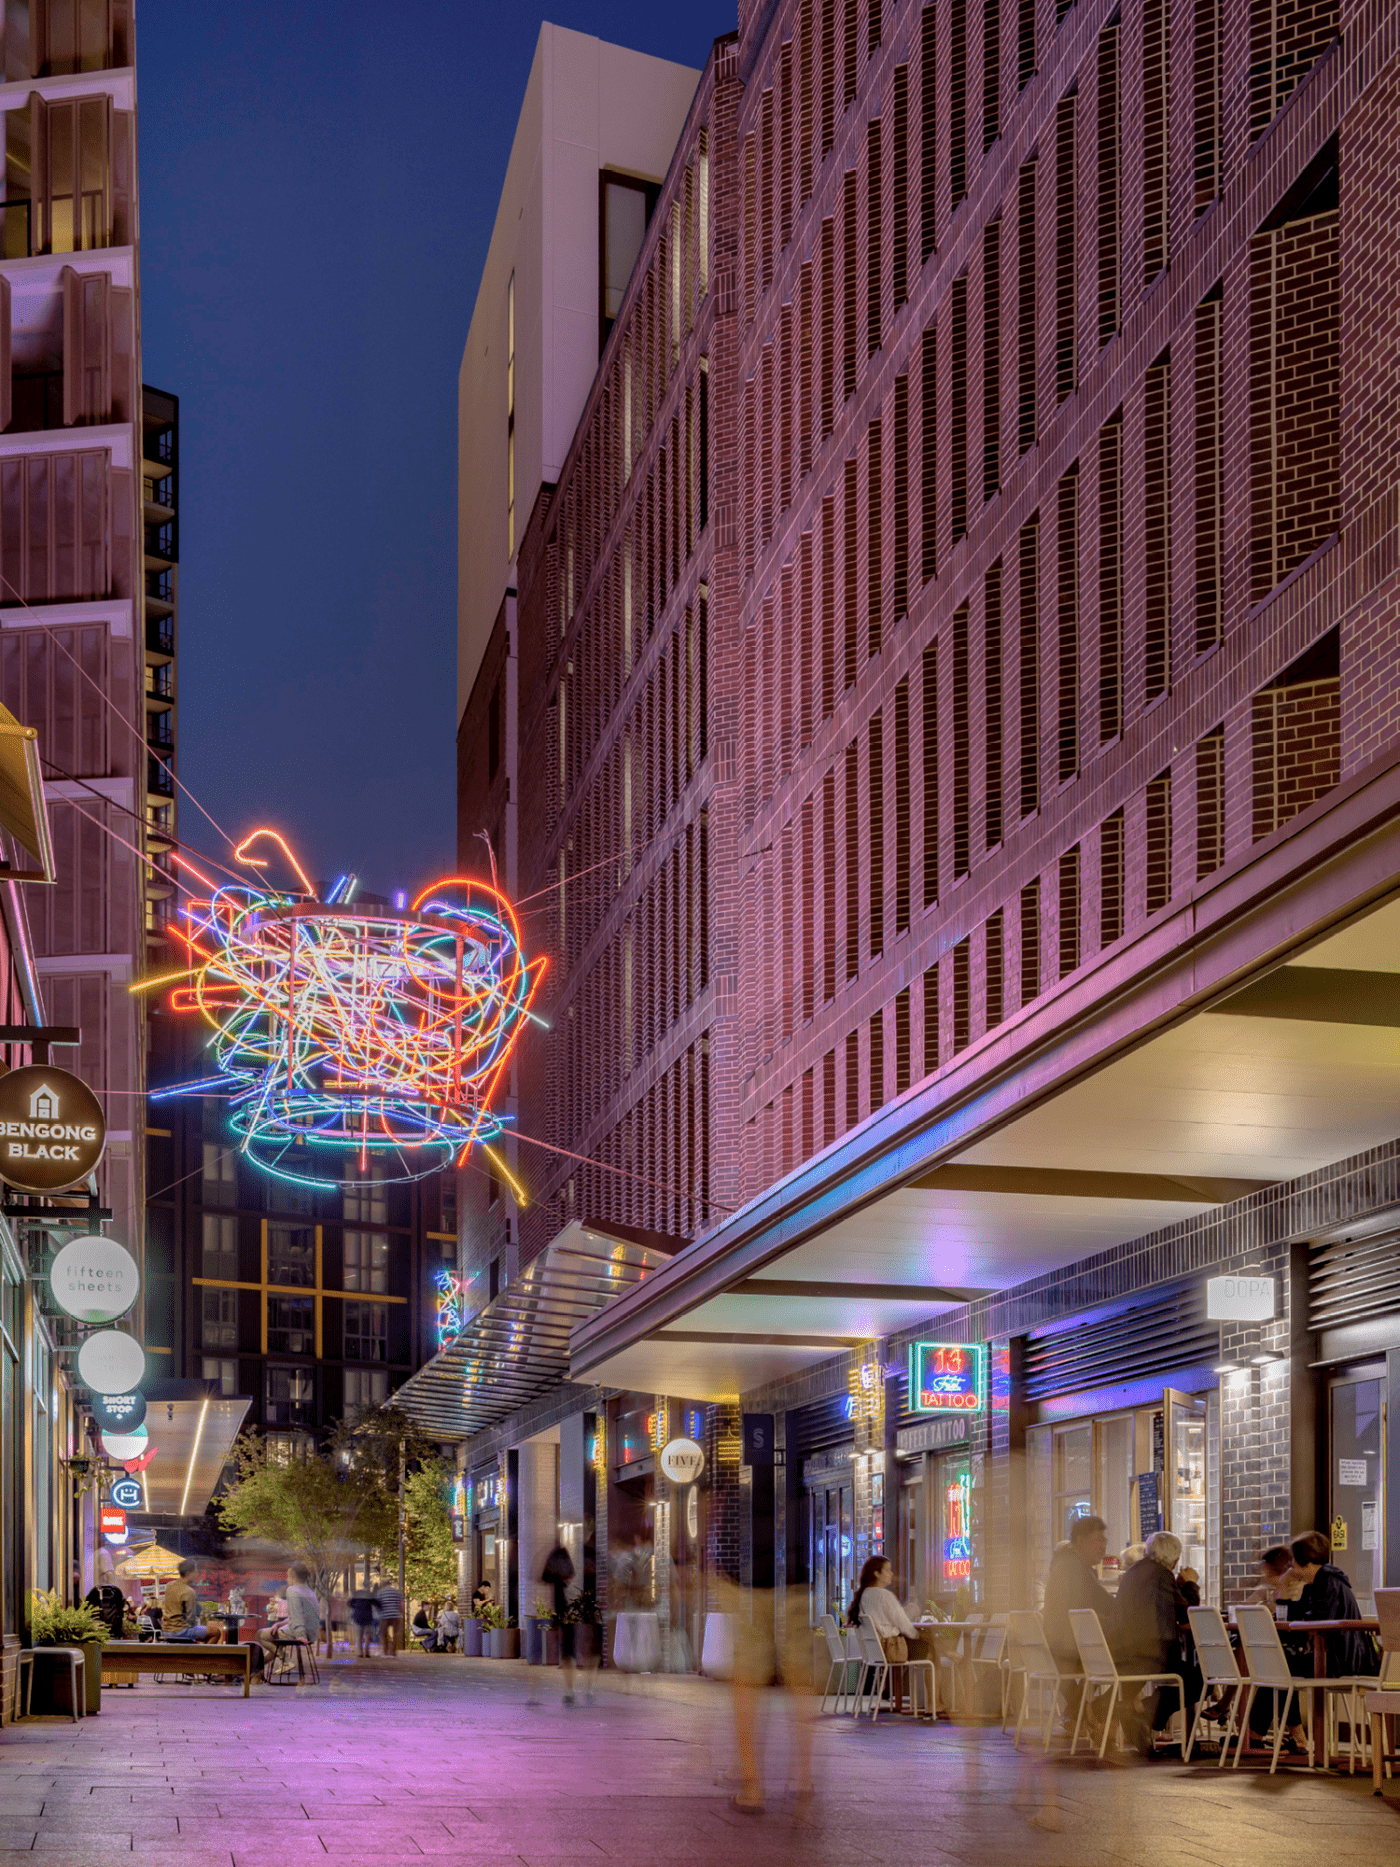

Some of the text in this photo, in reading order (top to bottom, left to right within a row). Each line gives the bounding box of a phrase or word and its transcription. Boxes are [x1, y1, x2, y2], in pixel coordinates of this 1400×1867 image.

[8, 1143, 80, 1161] BLACK
[66, 1266, 123, 1278] fifteen
[68, 1280, 122, 1292] sheets
[1224, 1279, 1270, 1298] DOPA
[937, 1347, 961, 1373] 13
[106, 1404, 133, 1413] STOP
[921, 1392, 978, 1409] TATTOO
[930, 1418, 966, 1444] TATTOO
